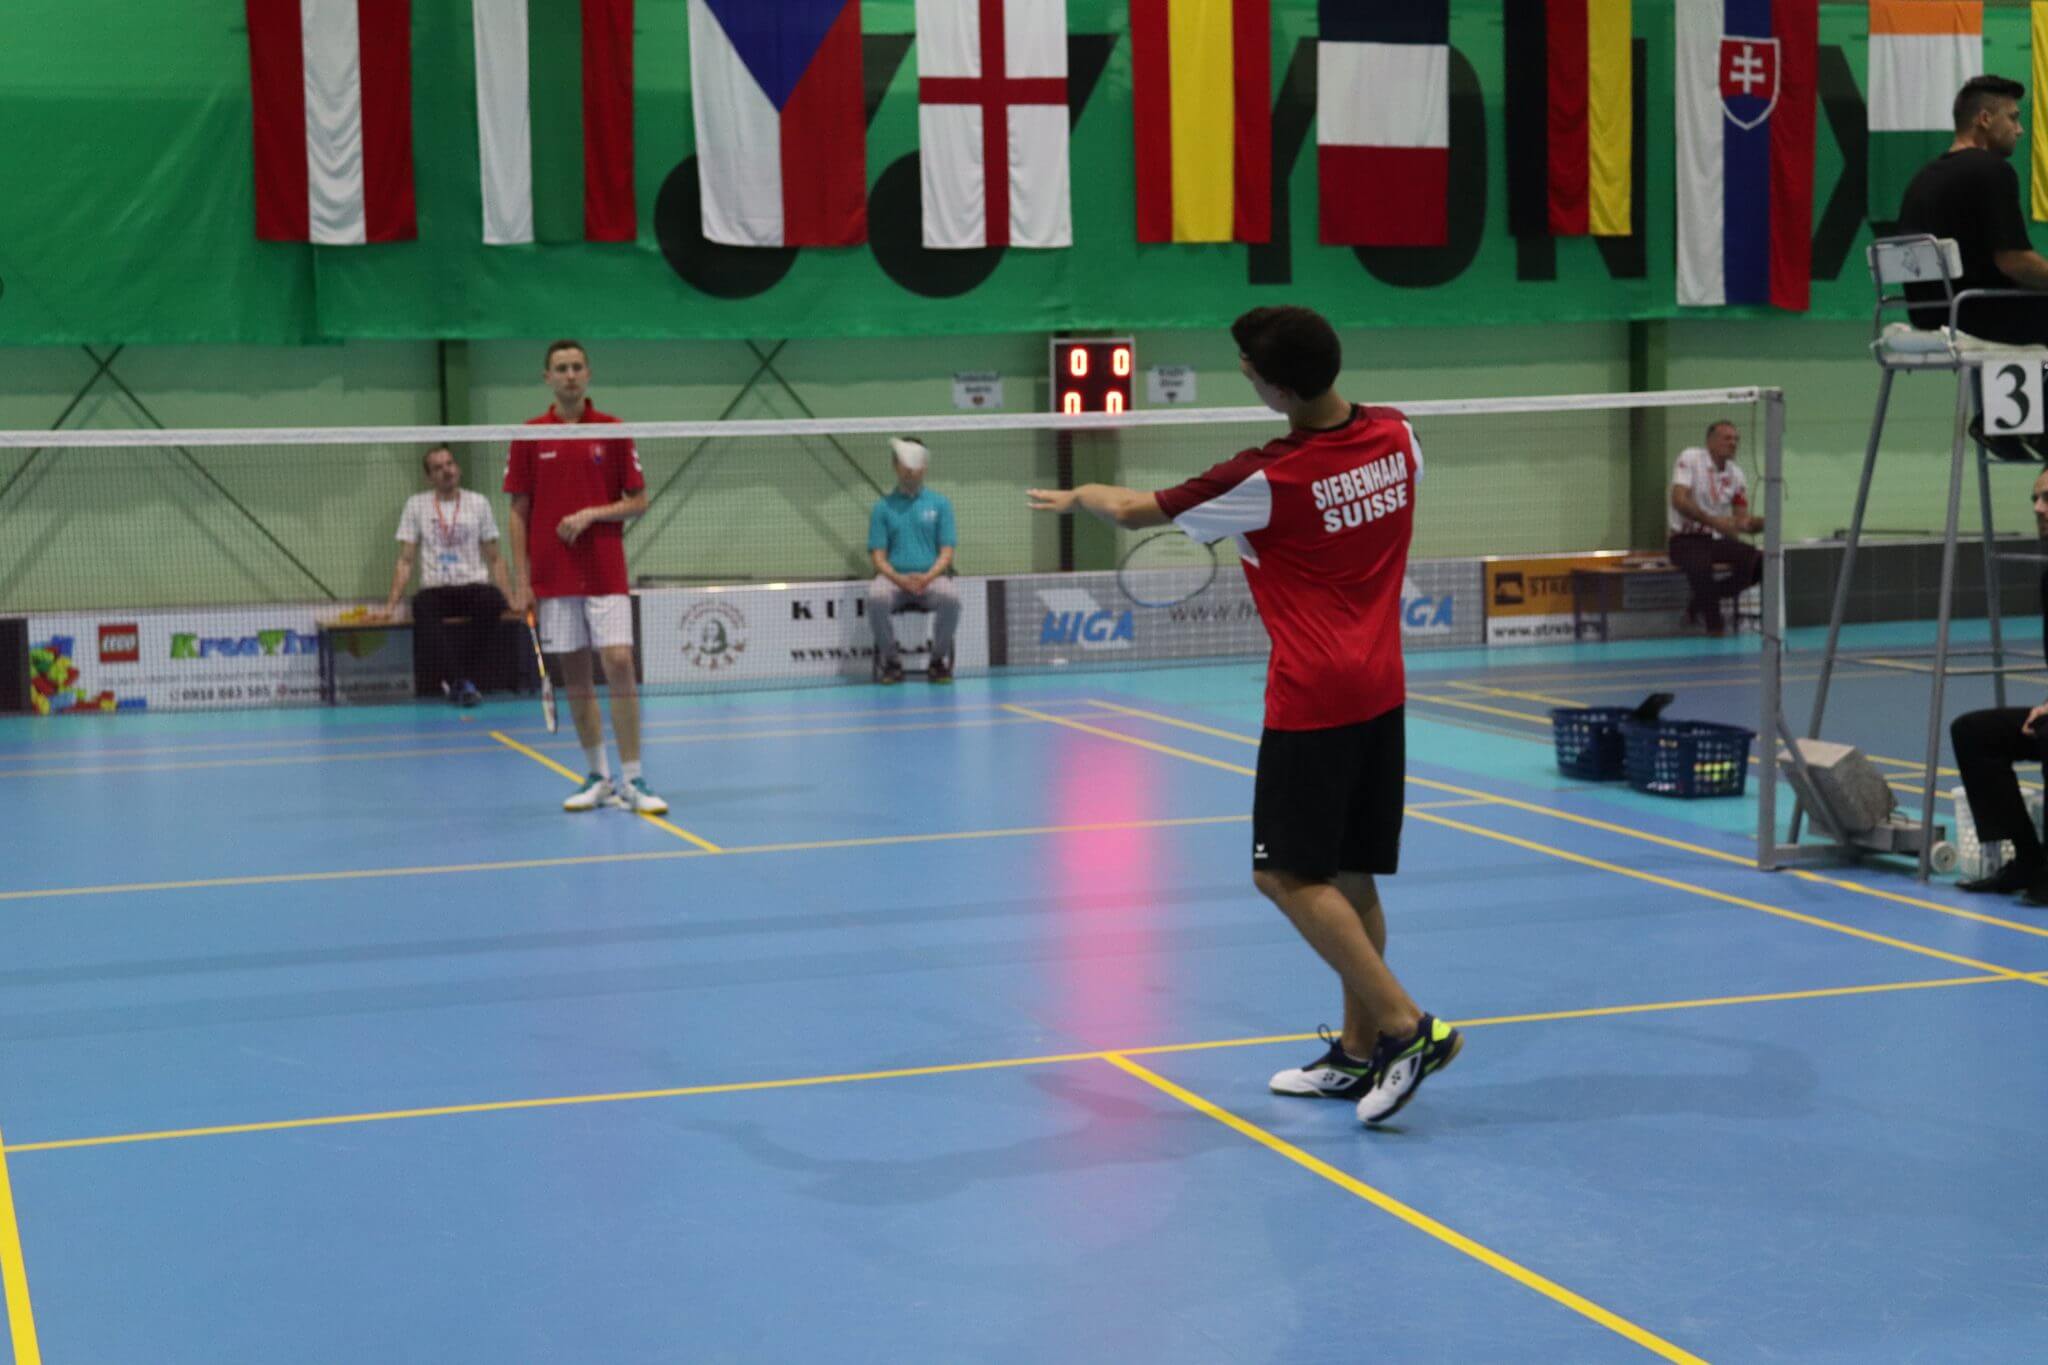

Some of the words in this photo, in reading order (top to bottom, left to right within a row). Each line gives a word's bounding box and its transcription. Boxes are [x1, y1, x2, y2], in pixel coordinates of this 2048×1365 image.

[1070, 347, 1088, 377] 0
[1113, 347, 1130, 377] 0
[1994, 363, 2030, 429] 3
[1311, 450, 1408, 511] SIEBENHAAR
[1322, 483, 1408, 533] SUISSE
